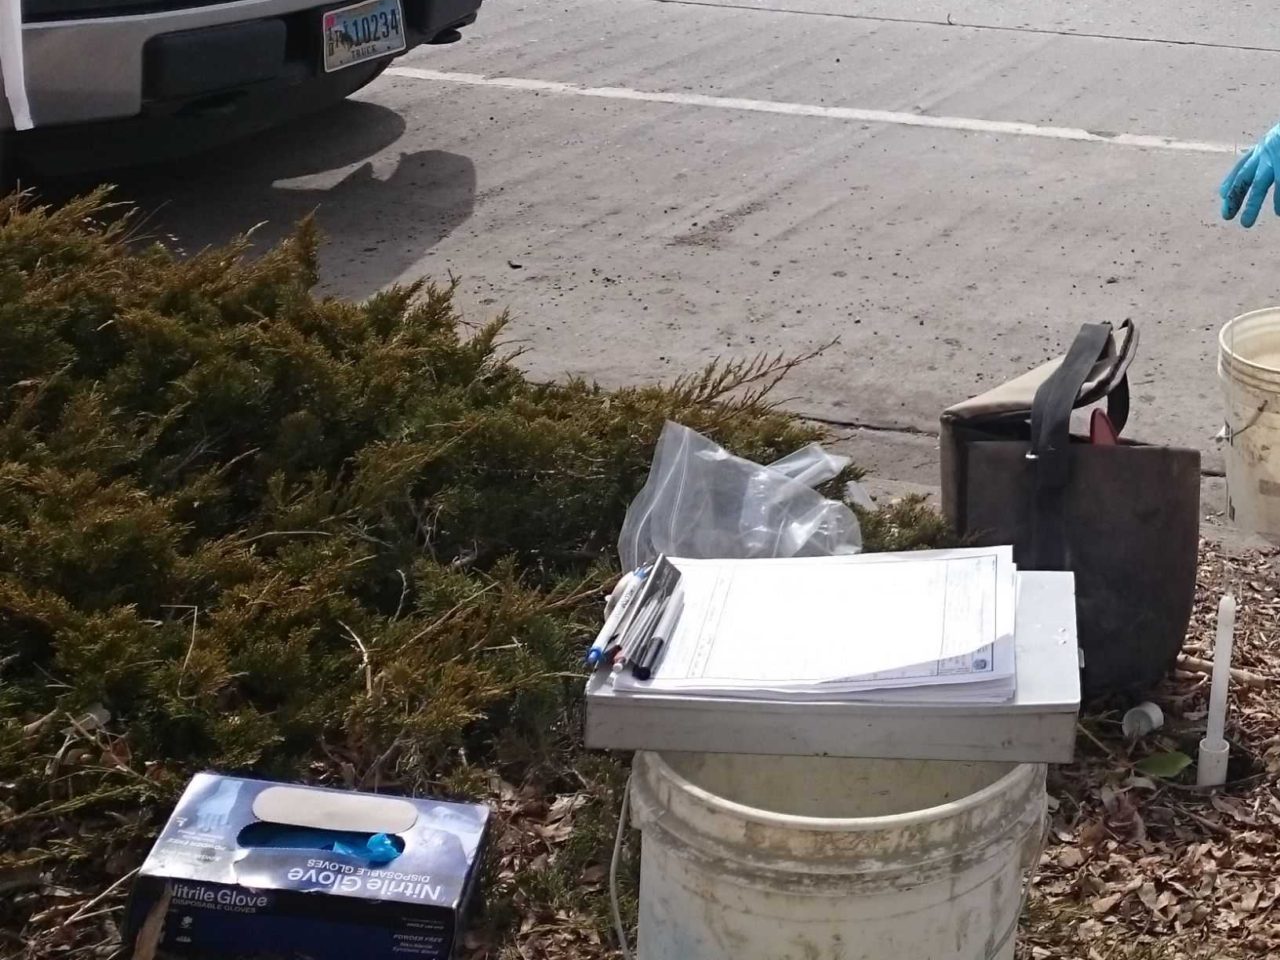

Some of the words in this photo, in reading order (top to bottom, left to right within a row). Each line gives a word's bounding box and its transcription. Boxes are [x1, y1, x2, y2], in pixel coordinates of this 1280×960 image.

[352, 8, 399, 47] 10234
[307, 859, 354, 874] GLOVES
[356, 868, 430, 883] DISPOSABLE
[287, 868, 362, 892] Glove
[217, 889, 268, 907] Glove
[366, 878, 441, 901] Nitrile
[224, 904, 256, 914] GLOVES
